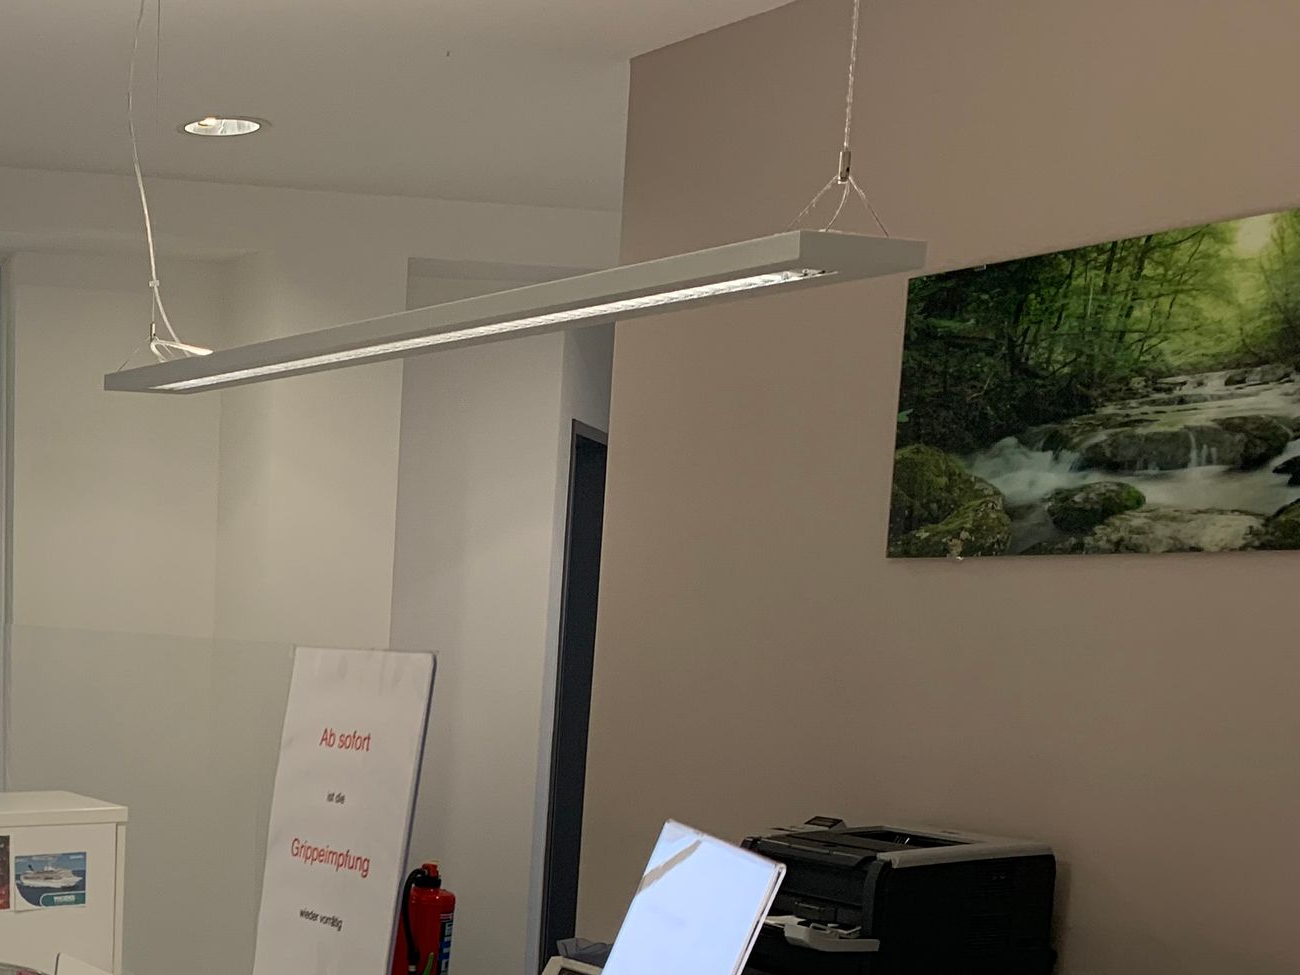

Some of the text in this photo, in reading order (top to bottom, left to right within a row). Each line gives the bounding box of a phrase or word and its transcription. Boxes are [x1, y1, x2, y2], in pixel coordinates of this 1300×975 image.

[319, 727, 371, 752] Ab sofort
[291, 838, 370, 878] Grippeimpfung
[300, 908, 319, 921] wieder
